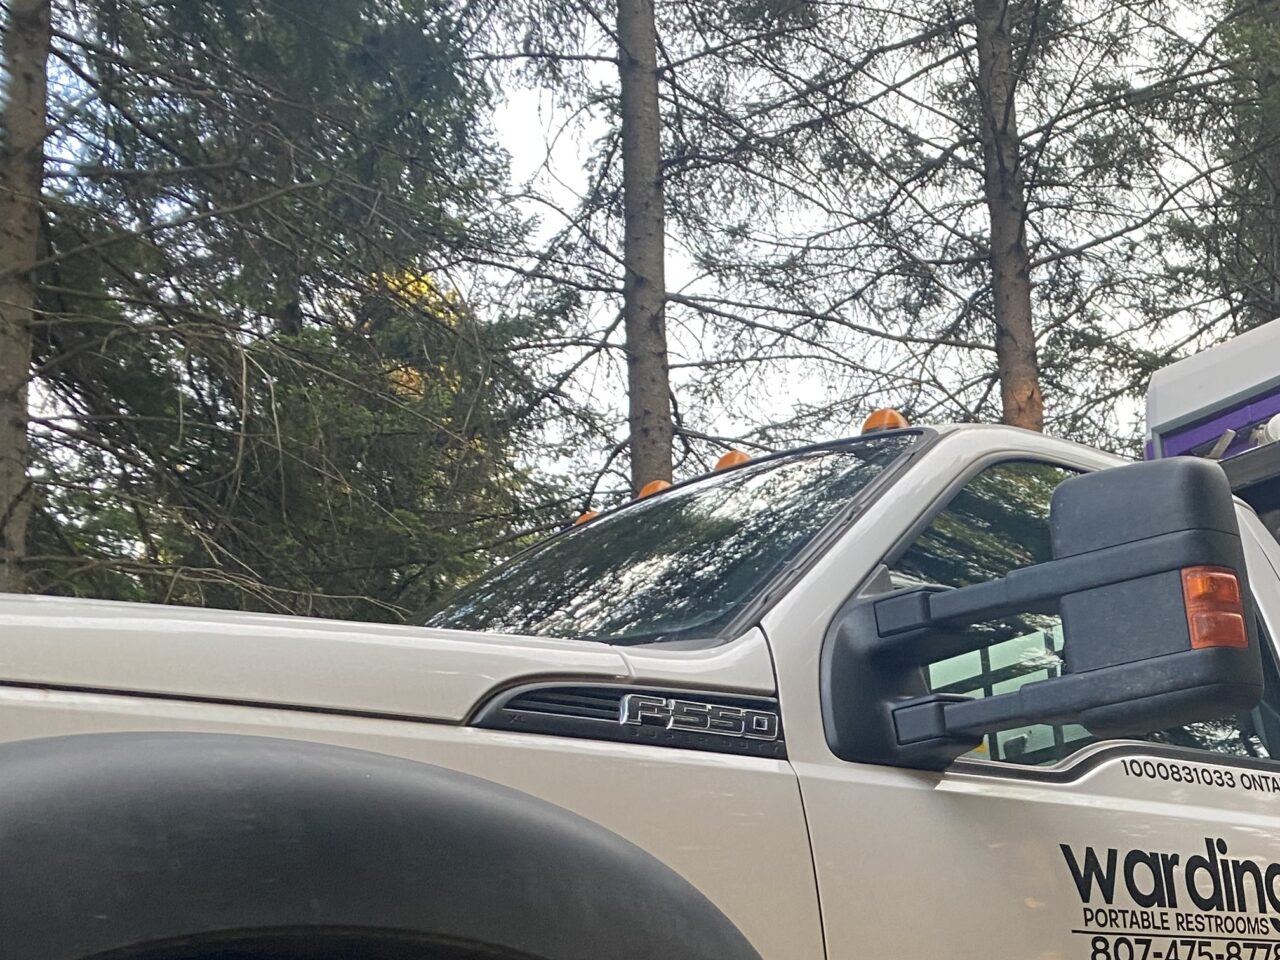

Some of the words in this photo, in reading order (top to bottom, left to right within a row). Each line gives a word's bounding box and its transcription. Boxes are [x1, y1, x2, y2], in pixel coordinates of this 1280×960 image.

[1121, 759, 1236, 788] 1000831033
[1083, 907, 1170, 931] PORTABLE
[1176, 913, 1270, 935] RESTROOMS
